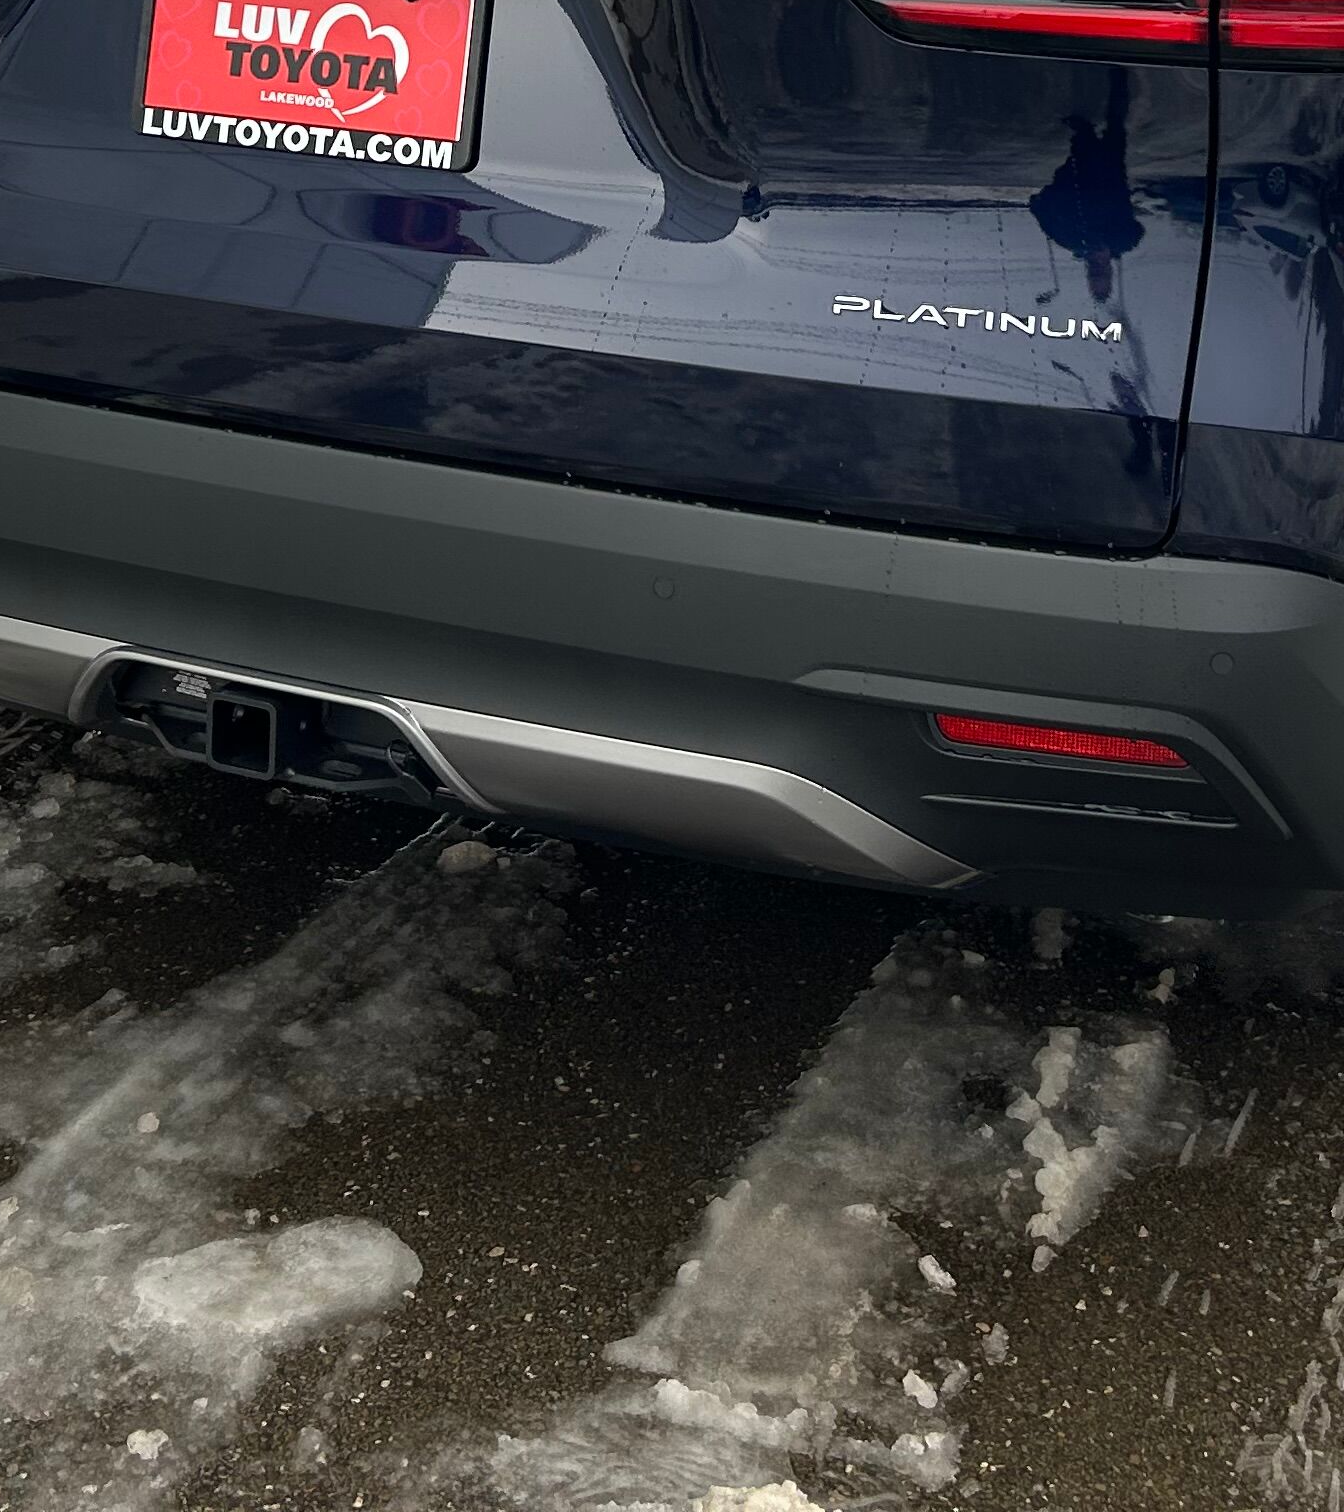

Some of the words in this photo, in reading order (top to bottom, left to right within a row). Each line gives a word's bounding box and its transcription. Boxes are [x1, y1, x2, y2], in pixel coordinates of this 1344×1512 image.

[213, 1, 311, 48] LUV
[225, 41, 398, 94] TOYOTA
[259, 90, 335, 109] LAKEWOOD
[141, 108, 453, 170] LUVTOYOTA.COM
[832, 295, 1123, 342] PLATINUM
